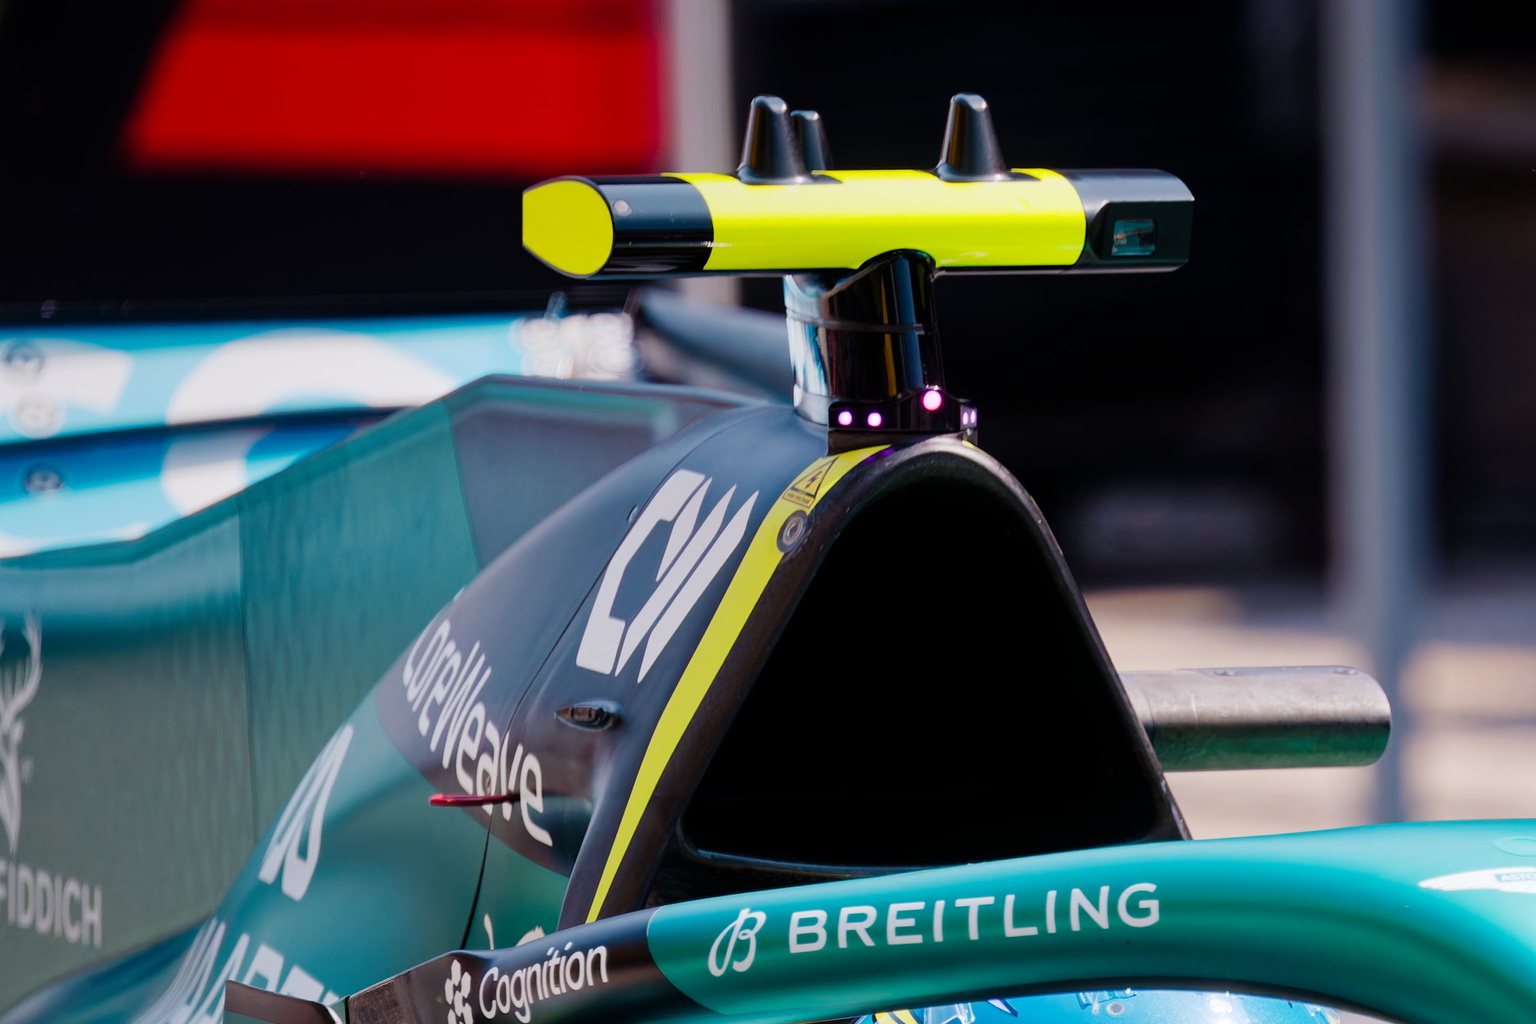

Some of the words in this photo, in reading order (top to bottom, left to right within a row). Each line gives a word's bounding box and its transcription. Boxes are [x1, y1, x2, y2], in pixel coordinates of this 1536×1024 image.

[402, 618, 554, 847] CoreWeave
[788, 882, 1161, 954] BREITLING
[478, 941, 609, 1024] Cognition
